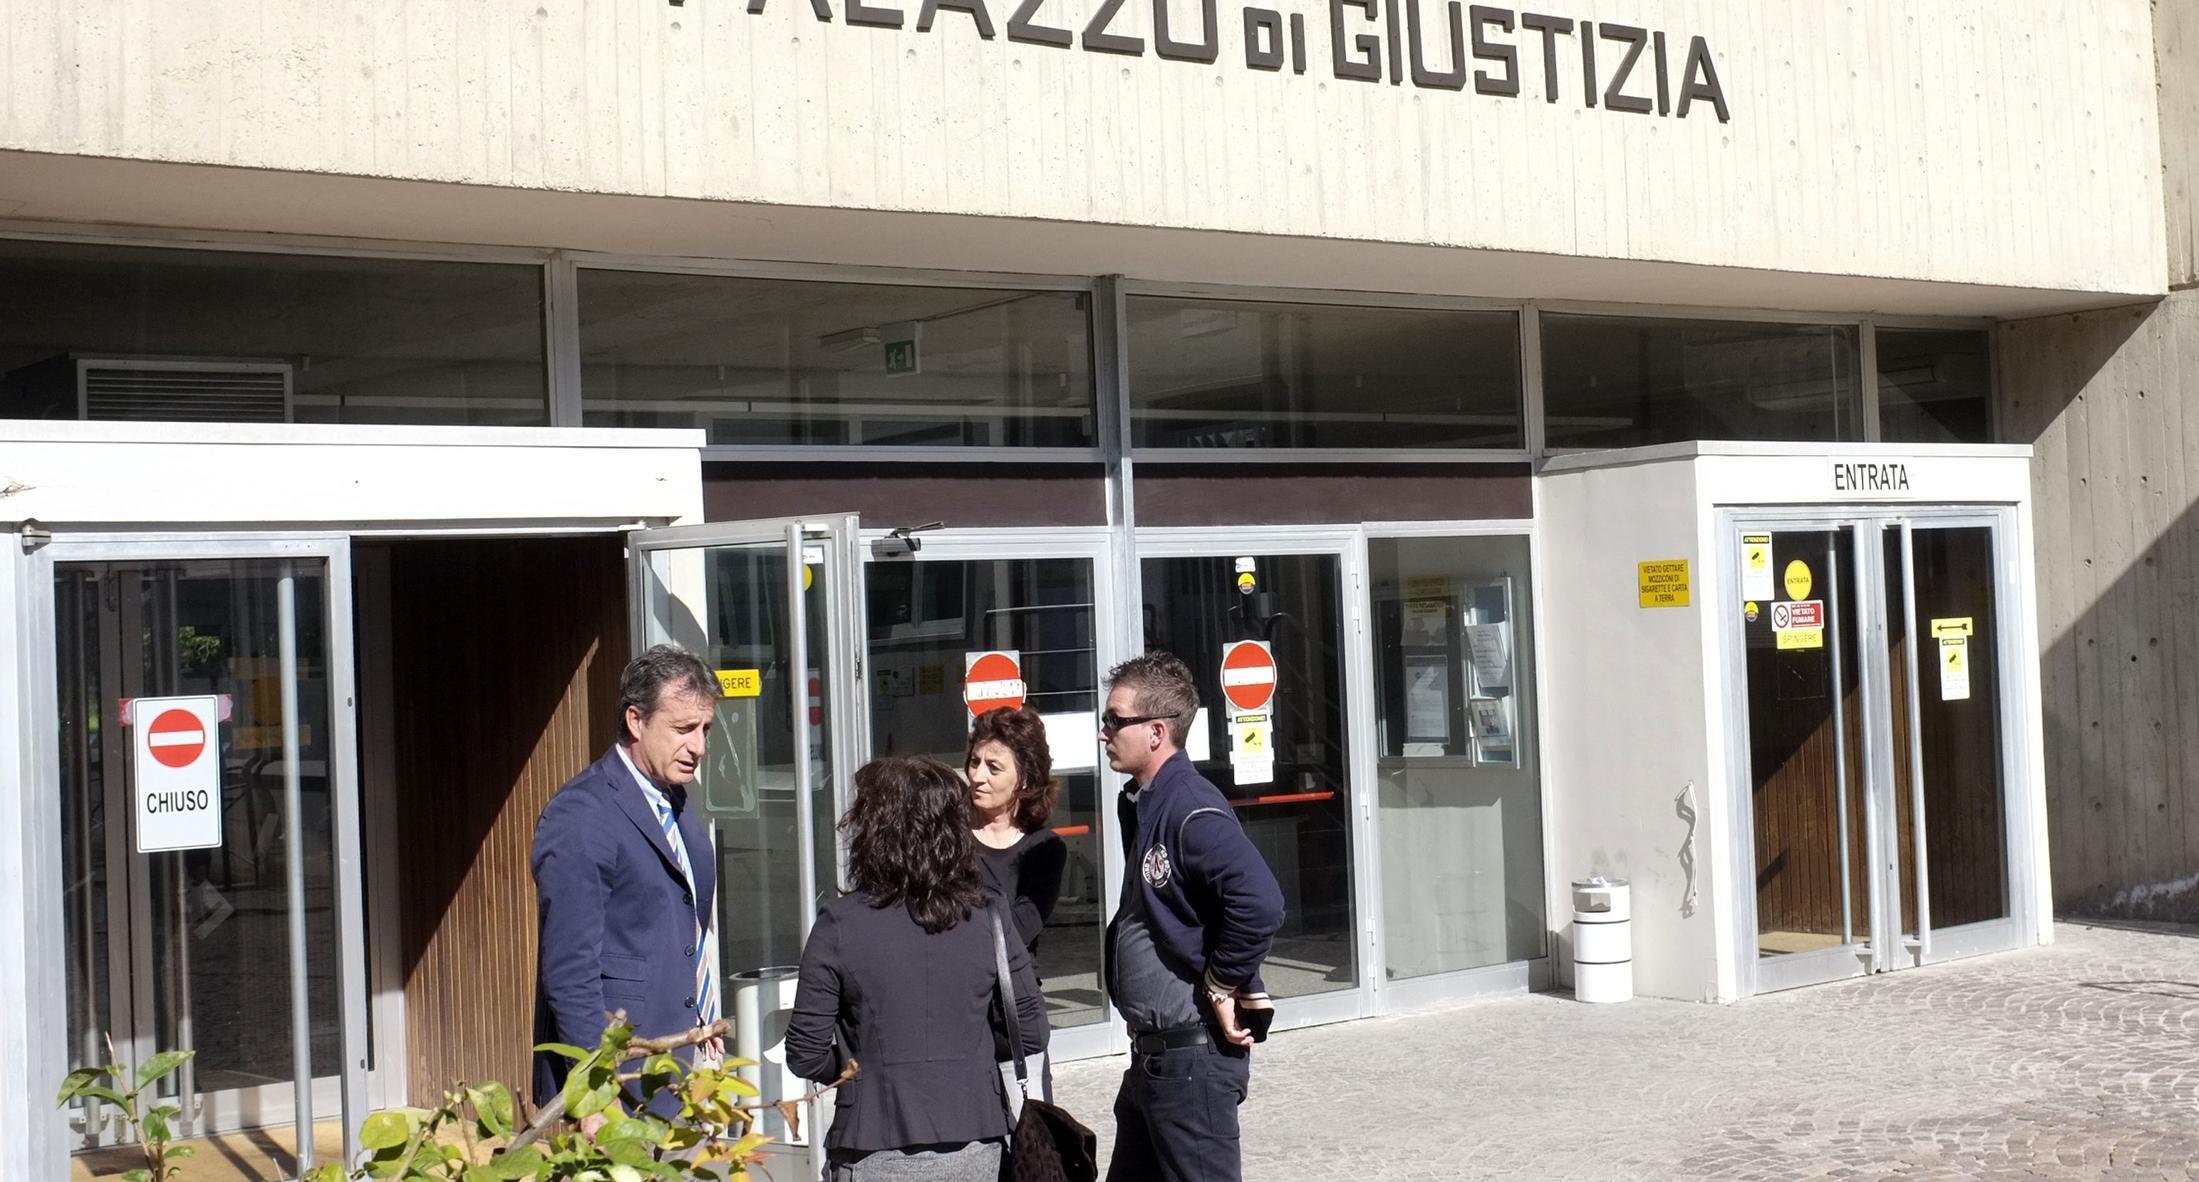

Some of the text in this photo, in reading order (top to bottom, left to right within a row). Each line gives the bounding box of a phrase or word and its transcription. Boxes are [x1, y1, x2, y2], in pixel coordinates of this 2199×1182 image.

[1330, 0, 1730, 124] GIUSTIZIA
[1834, 463, 1910, 491] ENTRATA
[1643, 564, 1685, 573] VIETATO GETTARE
[1648, 575, 1673, 583] MOZZICONI
[1641, 584, 1688, 593] SIGARETTE E CARTA
[1659, 594, 1675, 602] TERRA
[1782, 633, 1817, 643] SPINGERE
[147, 789, 208, 813] CHIUSO
